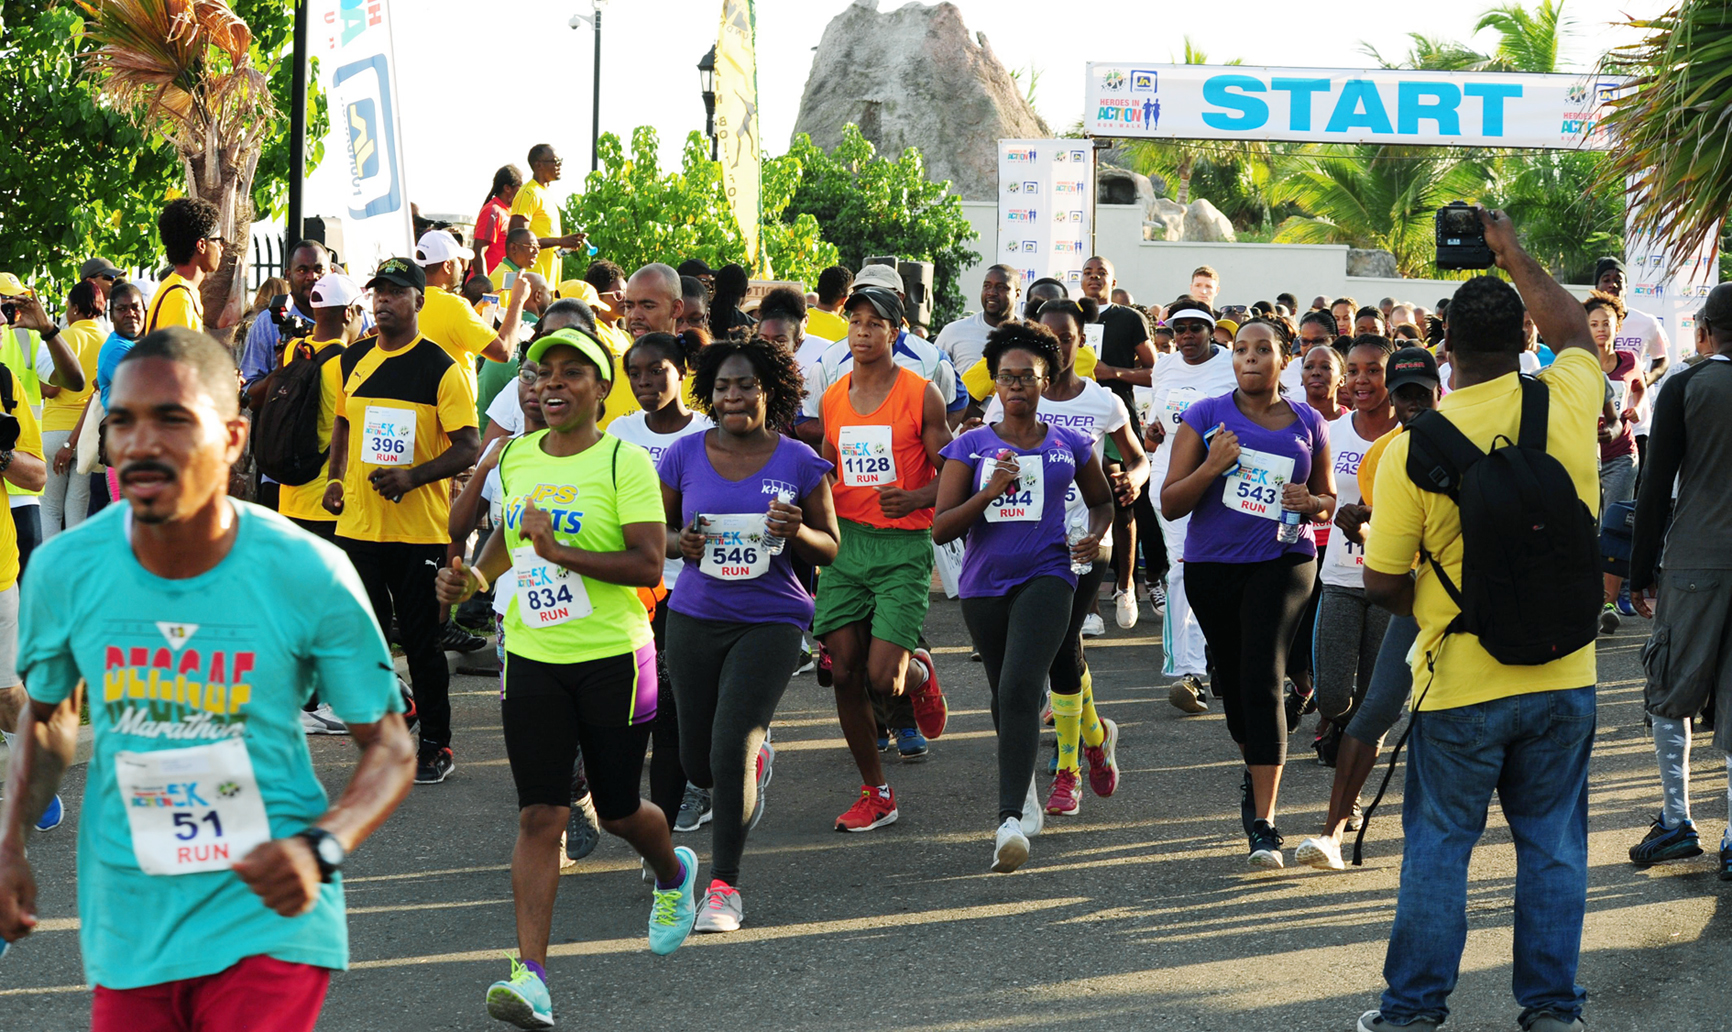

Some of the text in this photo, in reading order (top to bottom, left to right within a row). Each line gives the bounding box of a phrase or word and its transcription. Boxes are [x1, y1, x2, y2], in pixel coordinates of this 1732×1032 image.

[1099, 98, 1140, 107] HEROES IN
[1201, 74, 1524, 138] START
[1563, 112, 1593, 120] HEROES
[381, 423, 395, 437] 5K
[371, 437, 405, 453] 396
[856, 442, 871, 456] 5K
[376, 453, 398, 462] RUN
[845, 457, 890, 473] 1128
[856, 474, 879, 483] RUN
[1251, 468, 1269, 485] 5K
[524, 483, 579, 505] JPS
[992, 490, 1033, 507] 544
[1237, 482, 1276, 504] 543
[1000, 508, 1025, 517] RUN
[1241, 500, 1266, 513] RUN
[506, 496, 584, 535] VTS
[723, 531, 743, 545] 5K
[713, 547, 757, 564] 546
[531, 566, 553, 586] 5K
[722, 566, 750, 576] RUN
[528, 584, 573, 610] 834
[540, 607, 569, 622] RUN
[104, 645, 255, 726] REGGAE
[108, 704, 246, 740] Marathon
[173, 810, 223, 841] 51
[177, 844, 229, 864] RUN
